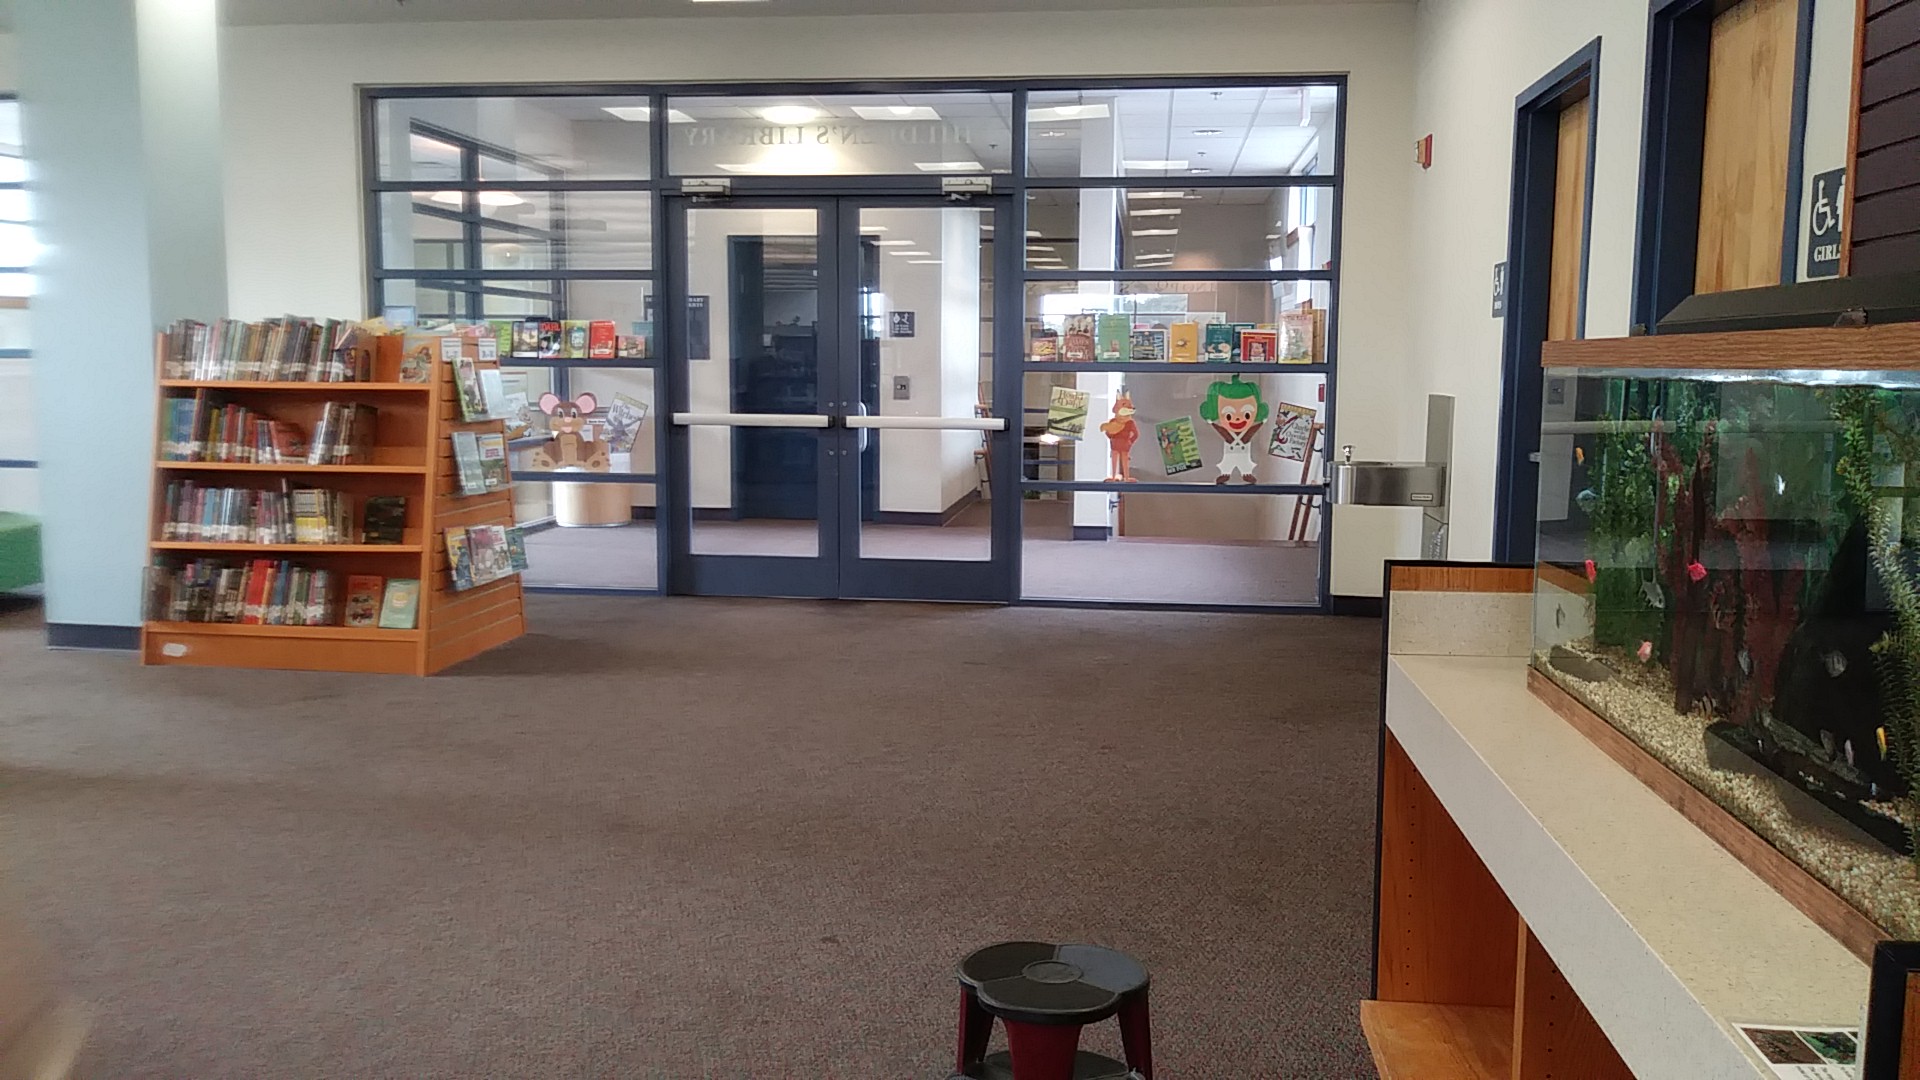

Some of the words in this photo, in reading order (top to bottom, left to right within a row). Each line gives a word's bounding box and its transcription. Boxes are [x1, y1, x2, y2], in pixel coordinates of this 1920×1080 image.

[1058, 389, 1085, 401] Roald
[1057, 397, 1081, 409] Dahl
[1176, 422, 1201, 466] DAHL
